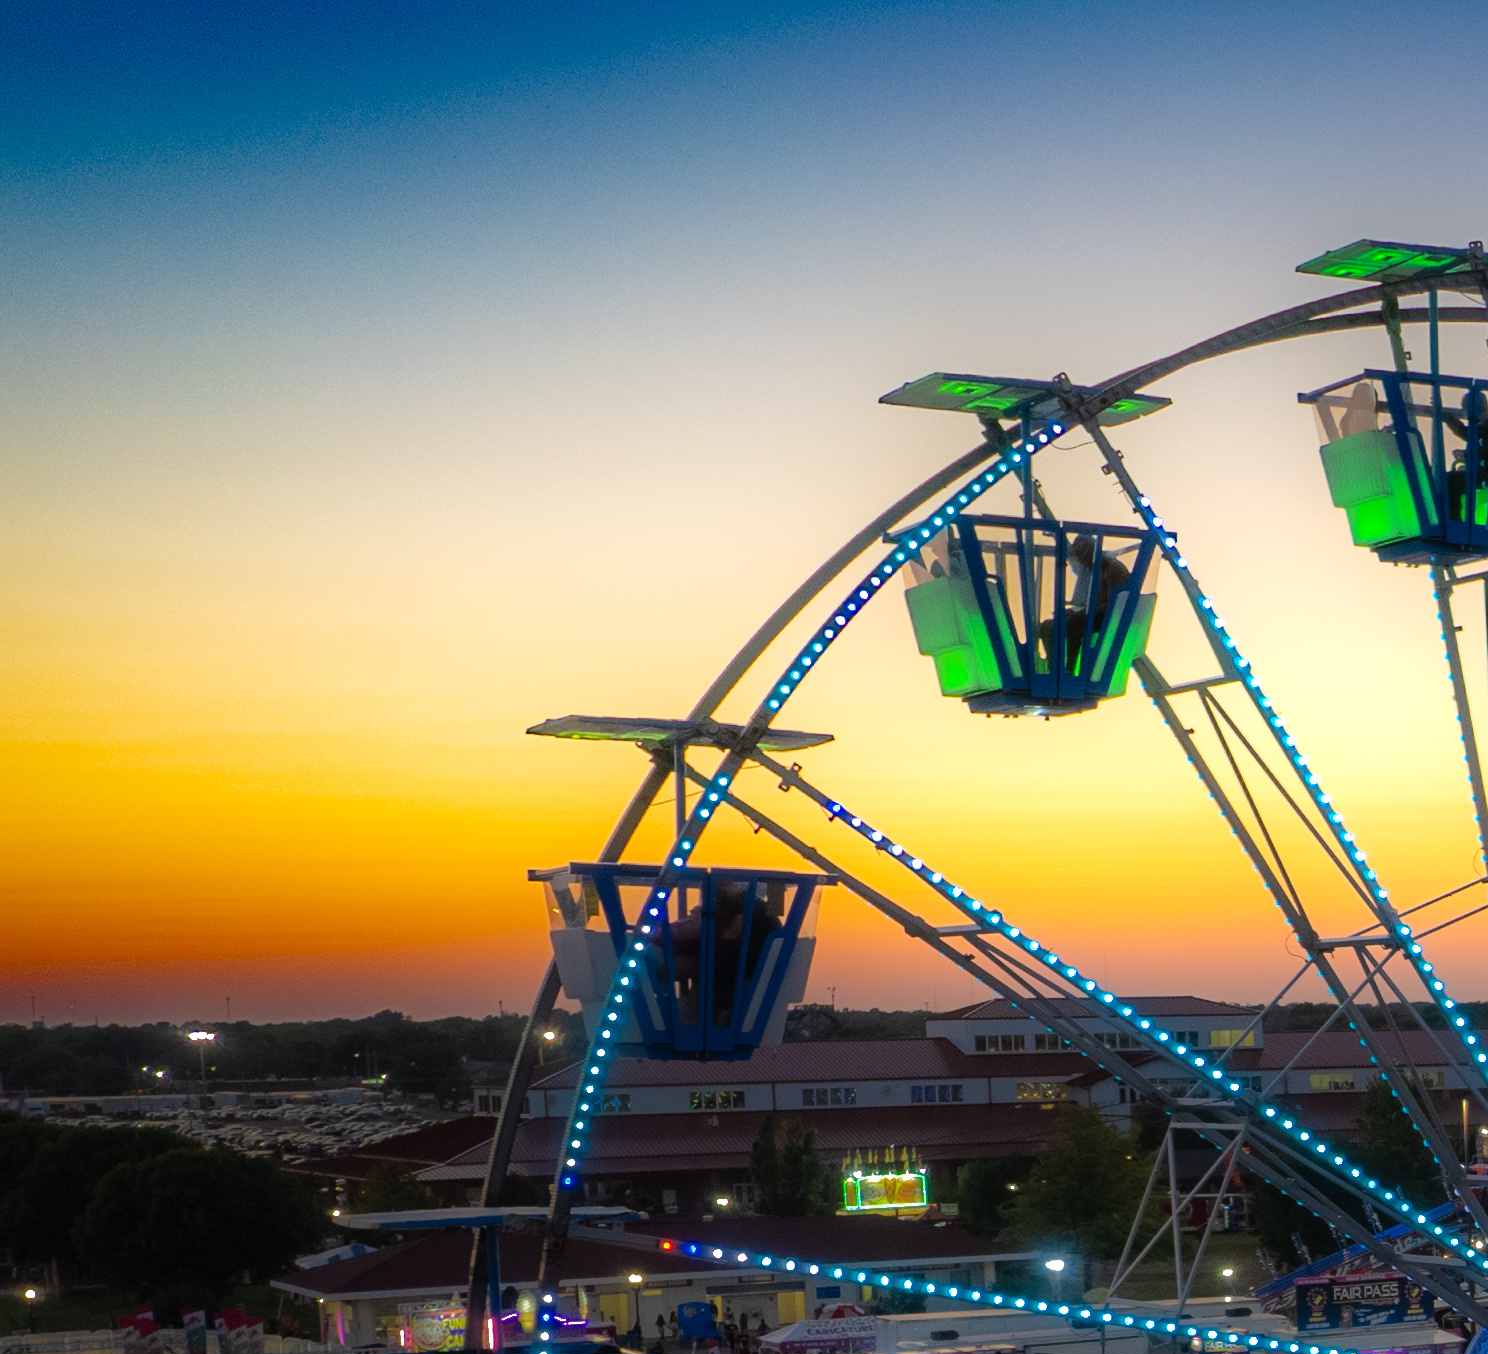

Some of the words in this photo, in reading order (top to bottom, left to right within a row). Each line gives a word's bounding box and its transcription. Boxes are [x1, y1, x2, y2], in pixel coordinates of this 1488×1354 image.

[1333, 1285, 1362, 1299] FAIR
[1363, 1282, 1399, 1297] PASS
[806, 1323, 876, 1336] CARICATURE
